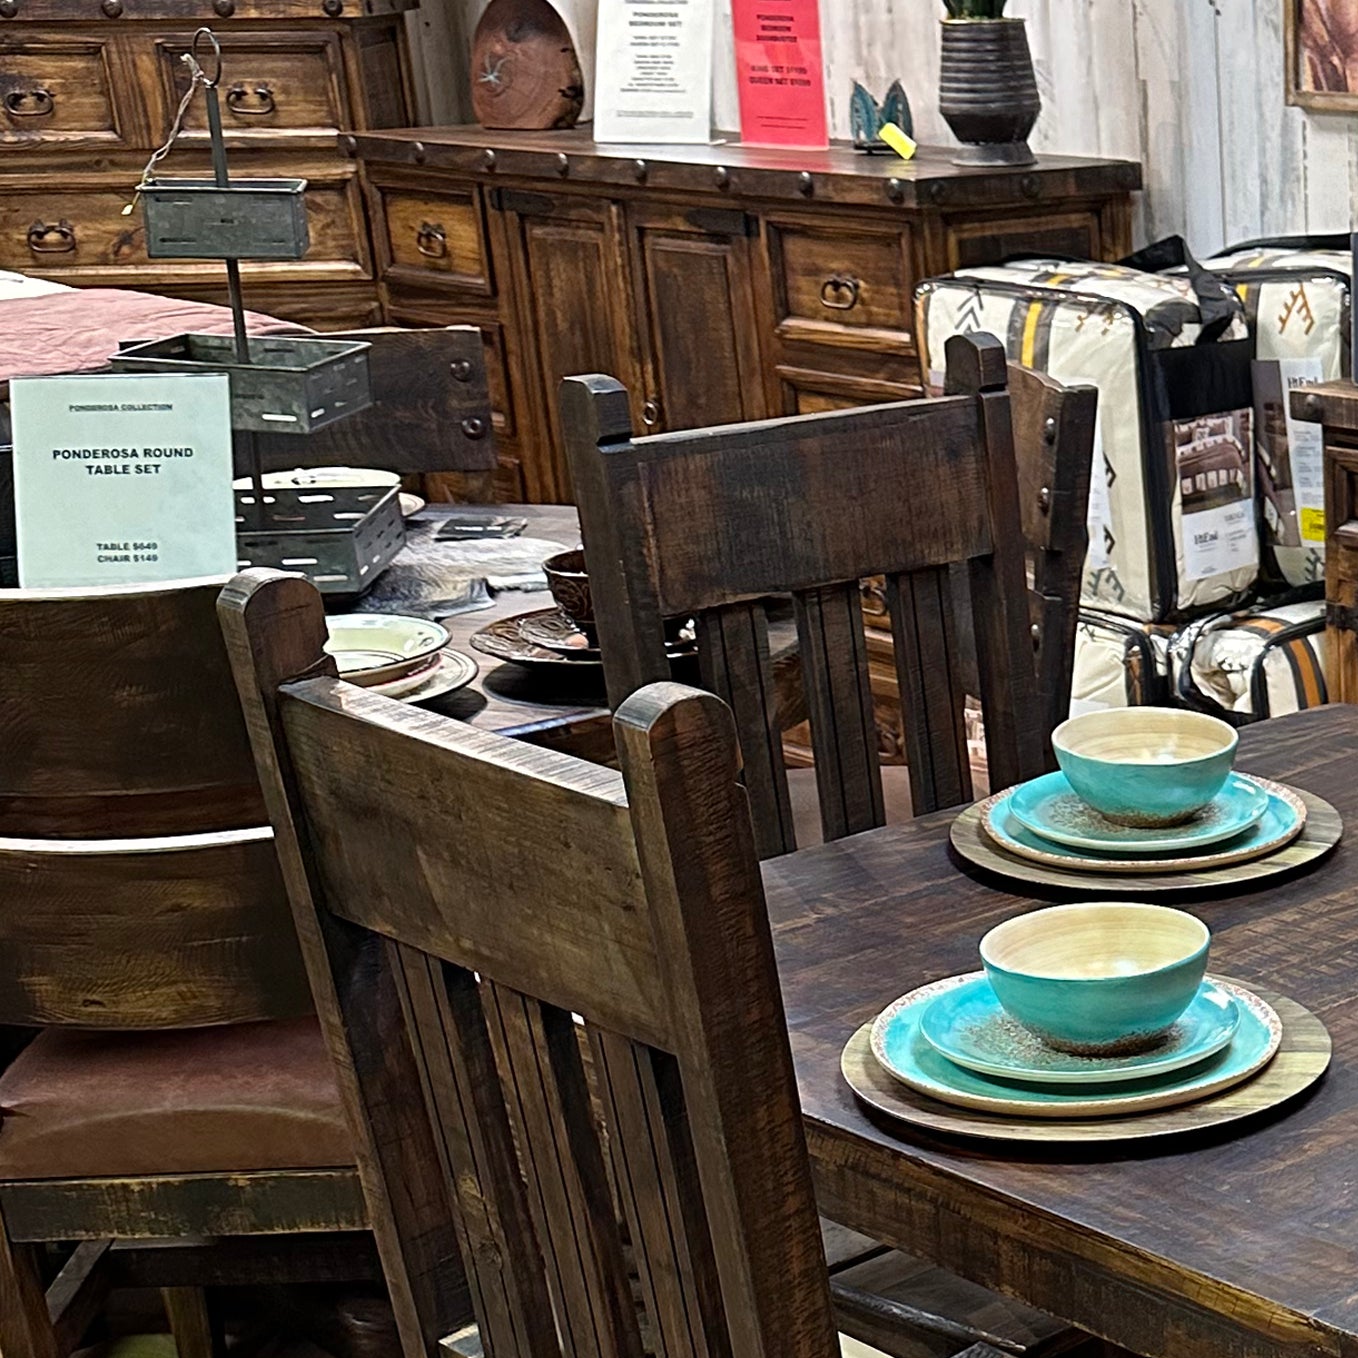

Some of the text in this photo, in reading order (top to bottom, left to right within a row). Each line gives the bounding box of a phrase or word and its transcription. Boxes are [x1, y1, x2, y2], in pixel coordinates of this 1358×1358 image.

[69, 403, 173, 412] PONDEROSA COLLECTION
[52, 447, 194, 460] PONDEROSA ROUND
[85, 464, 161, 475] TABLE SET
[96, 542, 130, 551] TABLE
[97, 554, 131, 563] CHAIR
